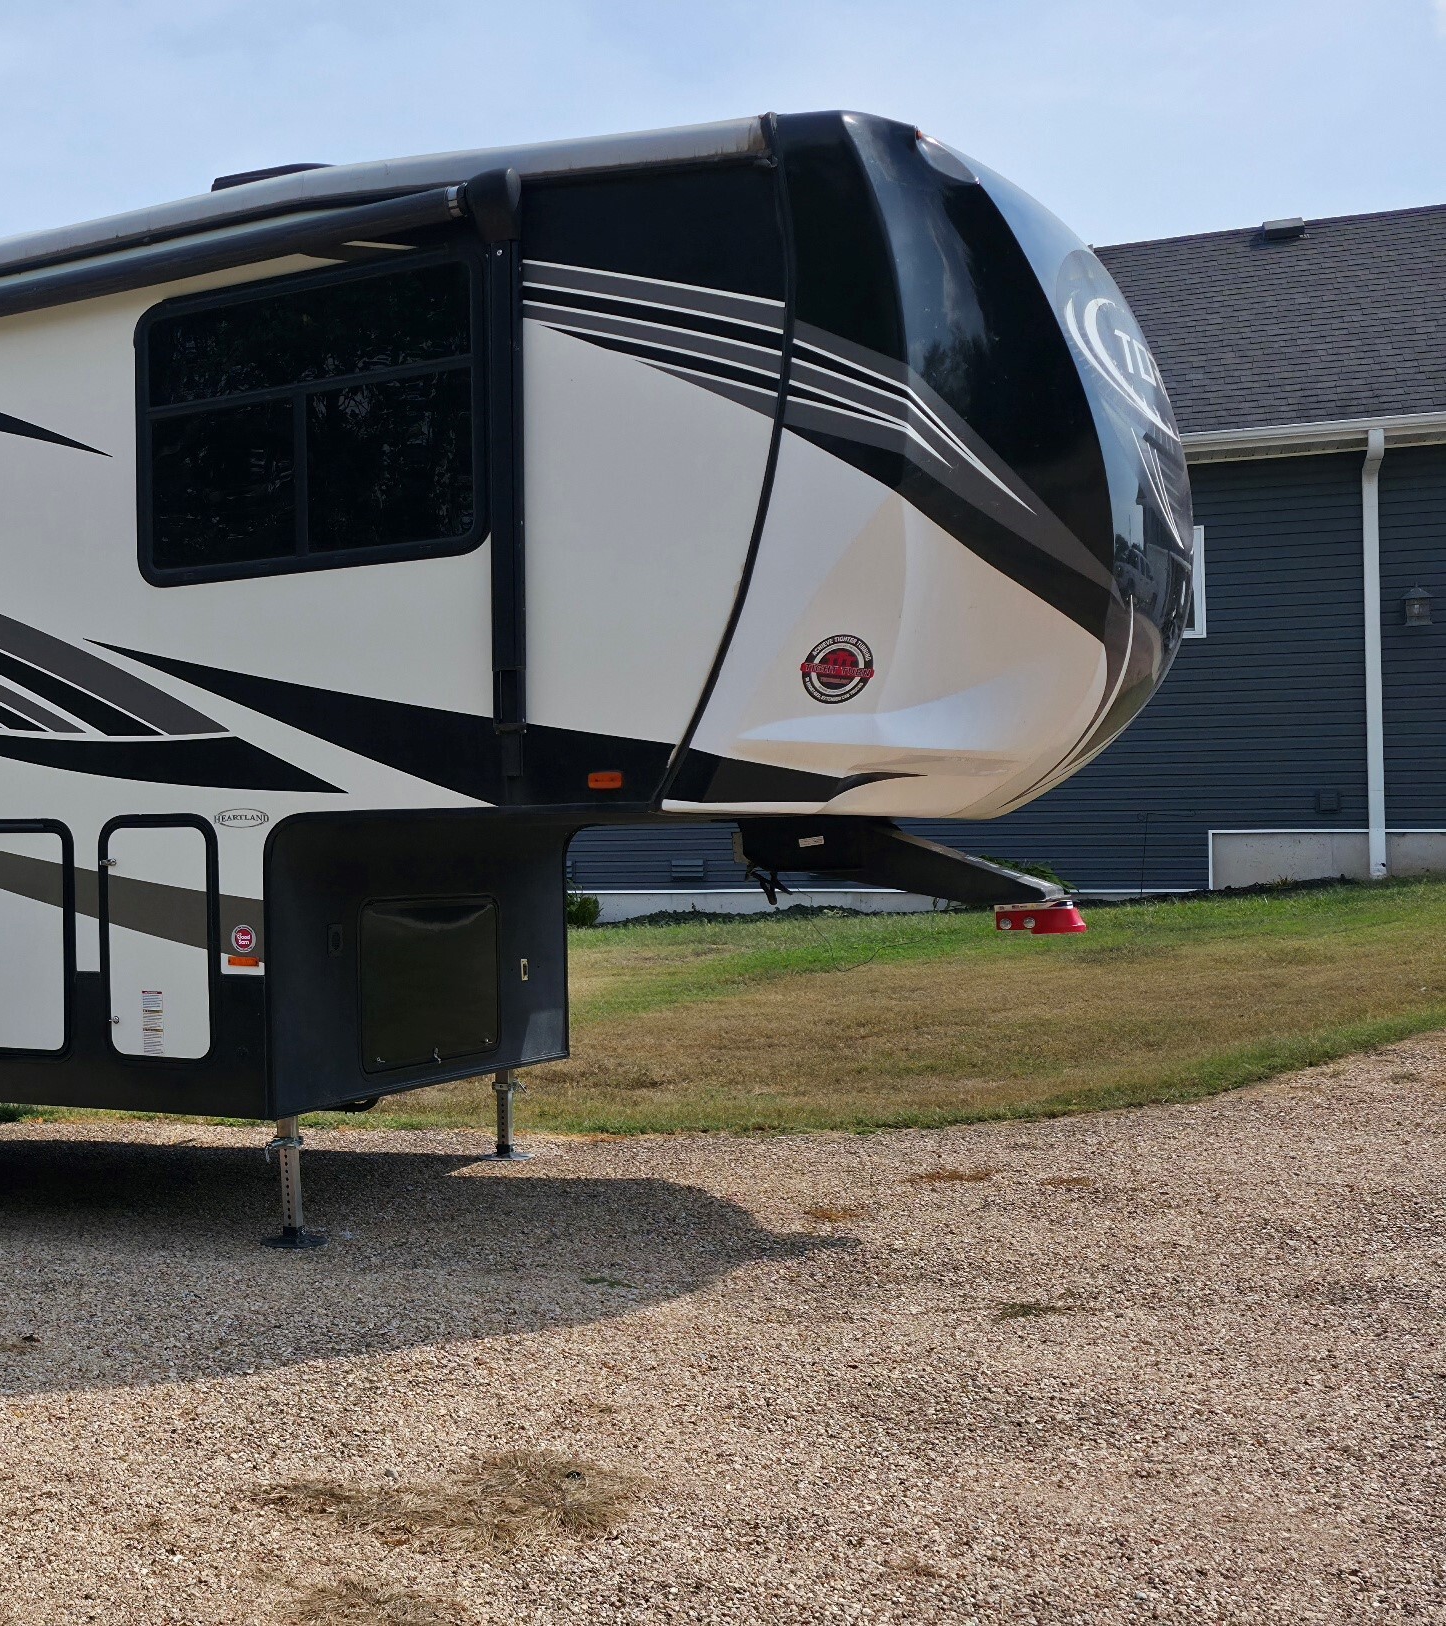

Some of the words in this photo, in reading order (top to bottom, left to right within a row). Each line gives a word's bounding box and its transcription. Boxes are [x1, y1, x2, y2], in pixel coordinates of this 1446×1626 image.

[812, 639, 833, 656] ACHIEVE
[805, 662, 839, 673] TIGHT
[841, 666, 872, 677] TURN
[214, 814, 269, 824] HEARTLAND
